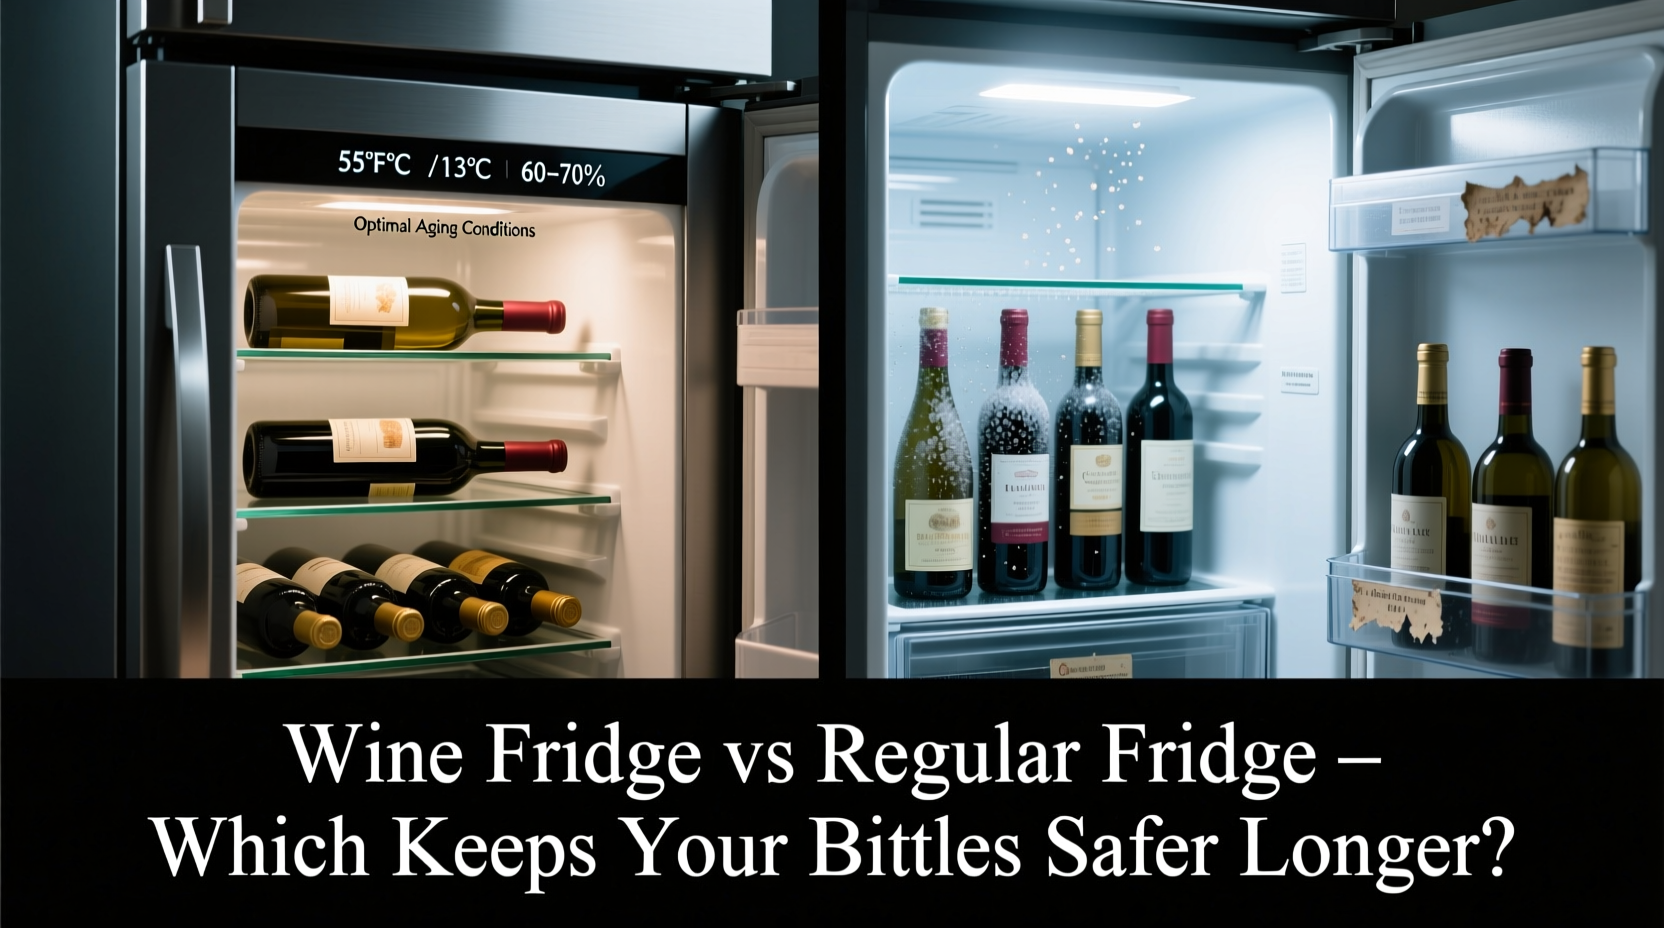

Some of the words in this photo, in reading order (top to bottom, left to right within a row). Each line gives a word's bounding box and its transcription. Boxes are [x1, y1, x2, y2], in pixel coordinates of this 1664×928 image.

[353, 215, 411, 236] Optimal
[415, 218, 458, 239] Aging
[461, 220, 536, 238] Conditions
